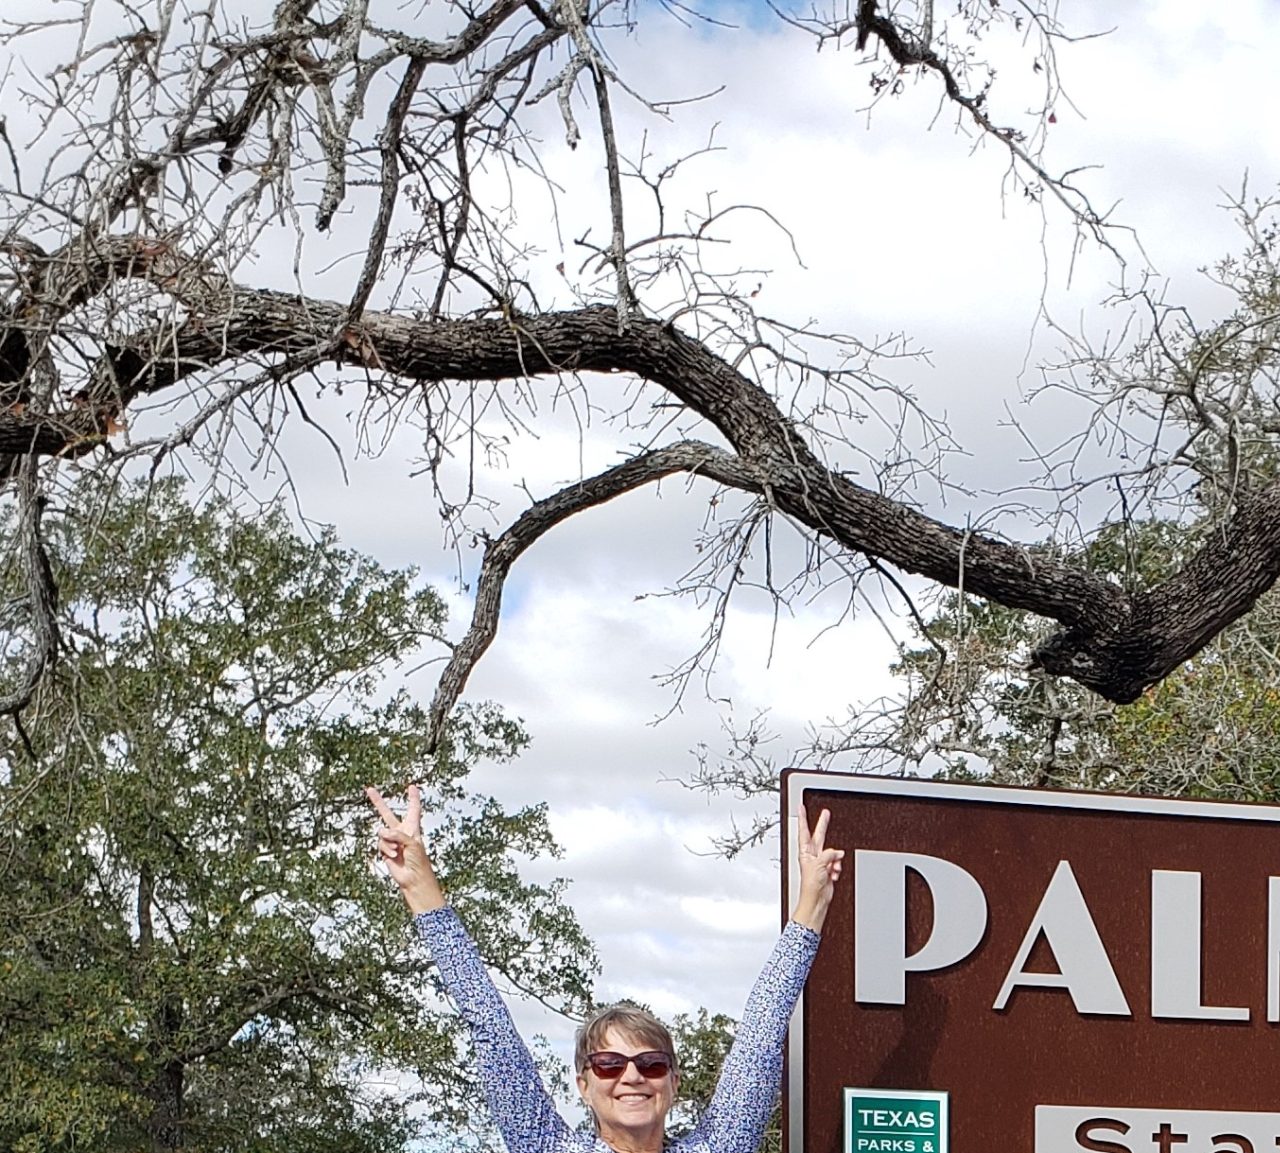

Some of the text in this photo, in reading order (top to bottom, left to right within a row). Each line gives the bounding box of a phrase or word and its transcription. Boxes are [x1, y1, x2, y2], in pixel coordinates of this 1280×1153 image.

[858, 1109, 935, 1128] TEXAS
[857, 1138, 935, 1153] PARKS &
